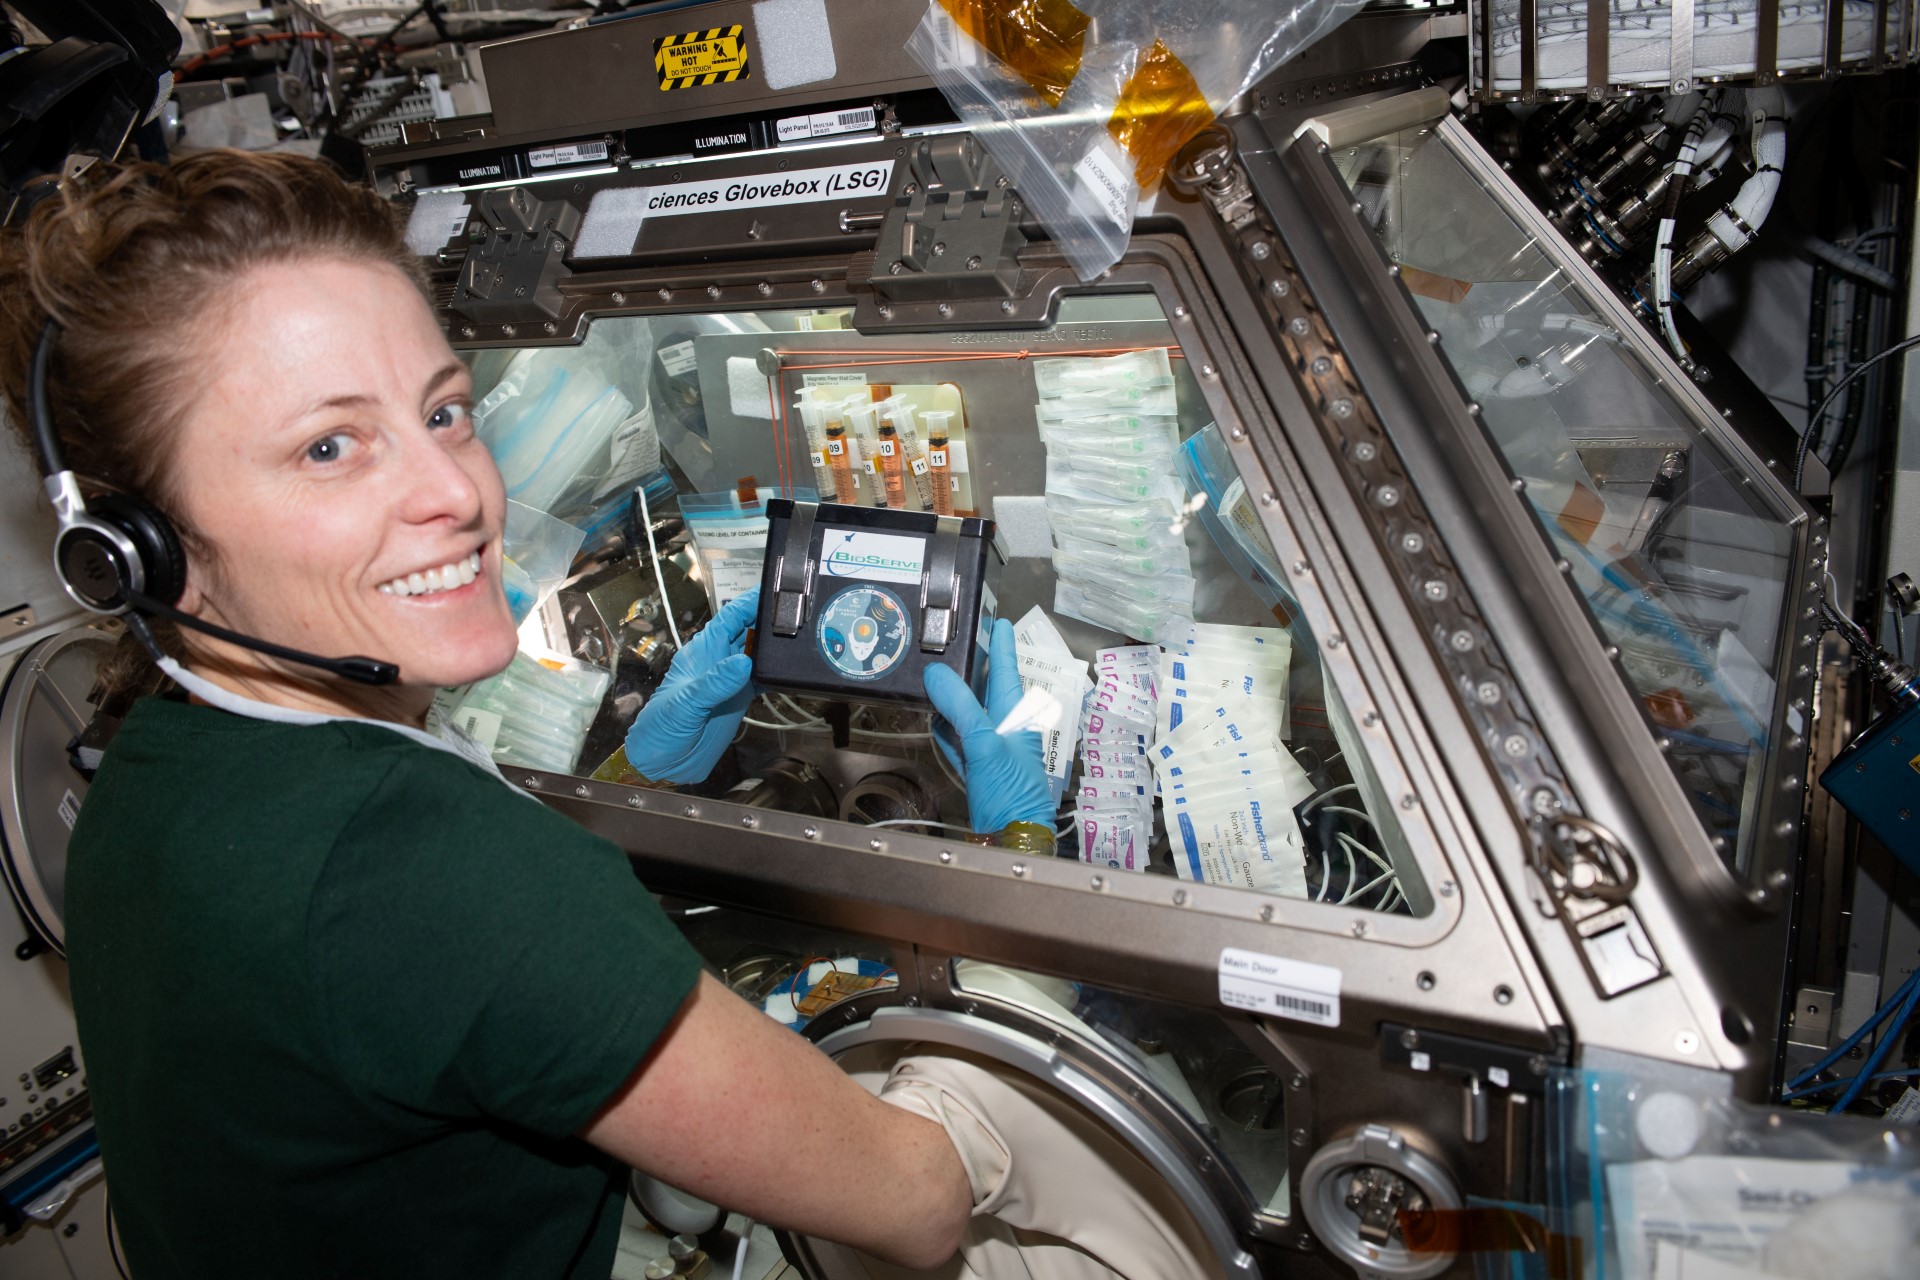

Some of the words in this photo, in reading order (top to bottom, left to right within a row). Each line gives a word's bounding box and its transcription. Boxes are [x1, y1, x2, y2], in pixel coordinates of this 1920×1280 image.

[669, 44, 708, 57] WARNING
[682, 56, 697, 66] HOT
[778, 125, 793, 135] Light
[793, 123, 808, 132] Panel
[695, 133, 746, 149] ILLUMINATION
[531, 152, 542, 161] Light
[459, 165, 500, 179] ILLUMINATION
[648, 190, 718, 210] ciences
[725, 179, 821, 202] Glovebox
[826, 169, 888, 196] (LSG)
[830, 444, 839, 452] 09
[881, 445, 891, 453] 10
[933, 455, 943, 463] 11
[1050, 730, 1060, 773] Sani-Cloth
[1250, 801, 1272, 862] Fisherbrand
[1243, 862, 1254, 888] Gauze
[1224, 957, 1248, 969] Main
[1252, 962, 1279, 975] Door
